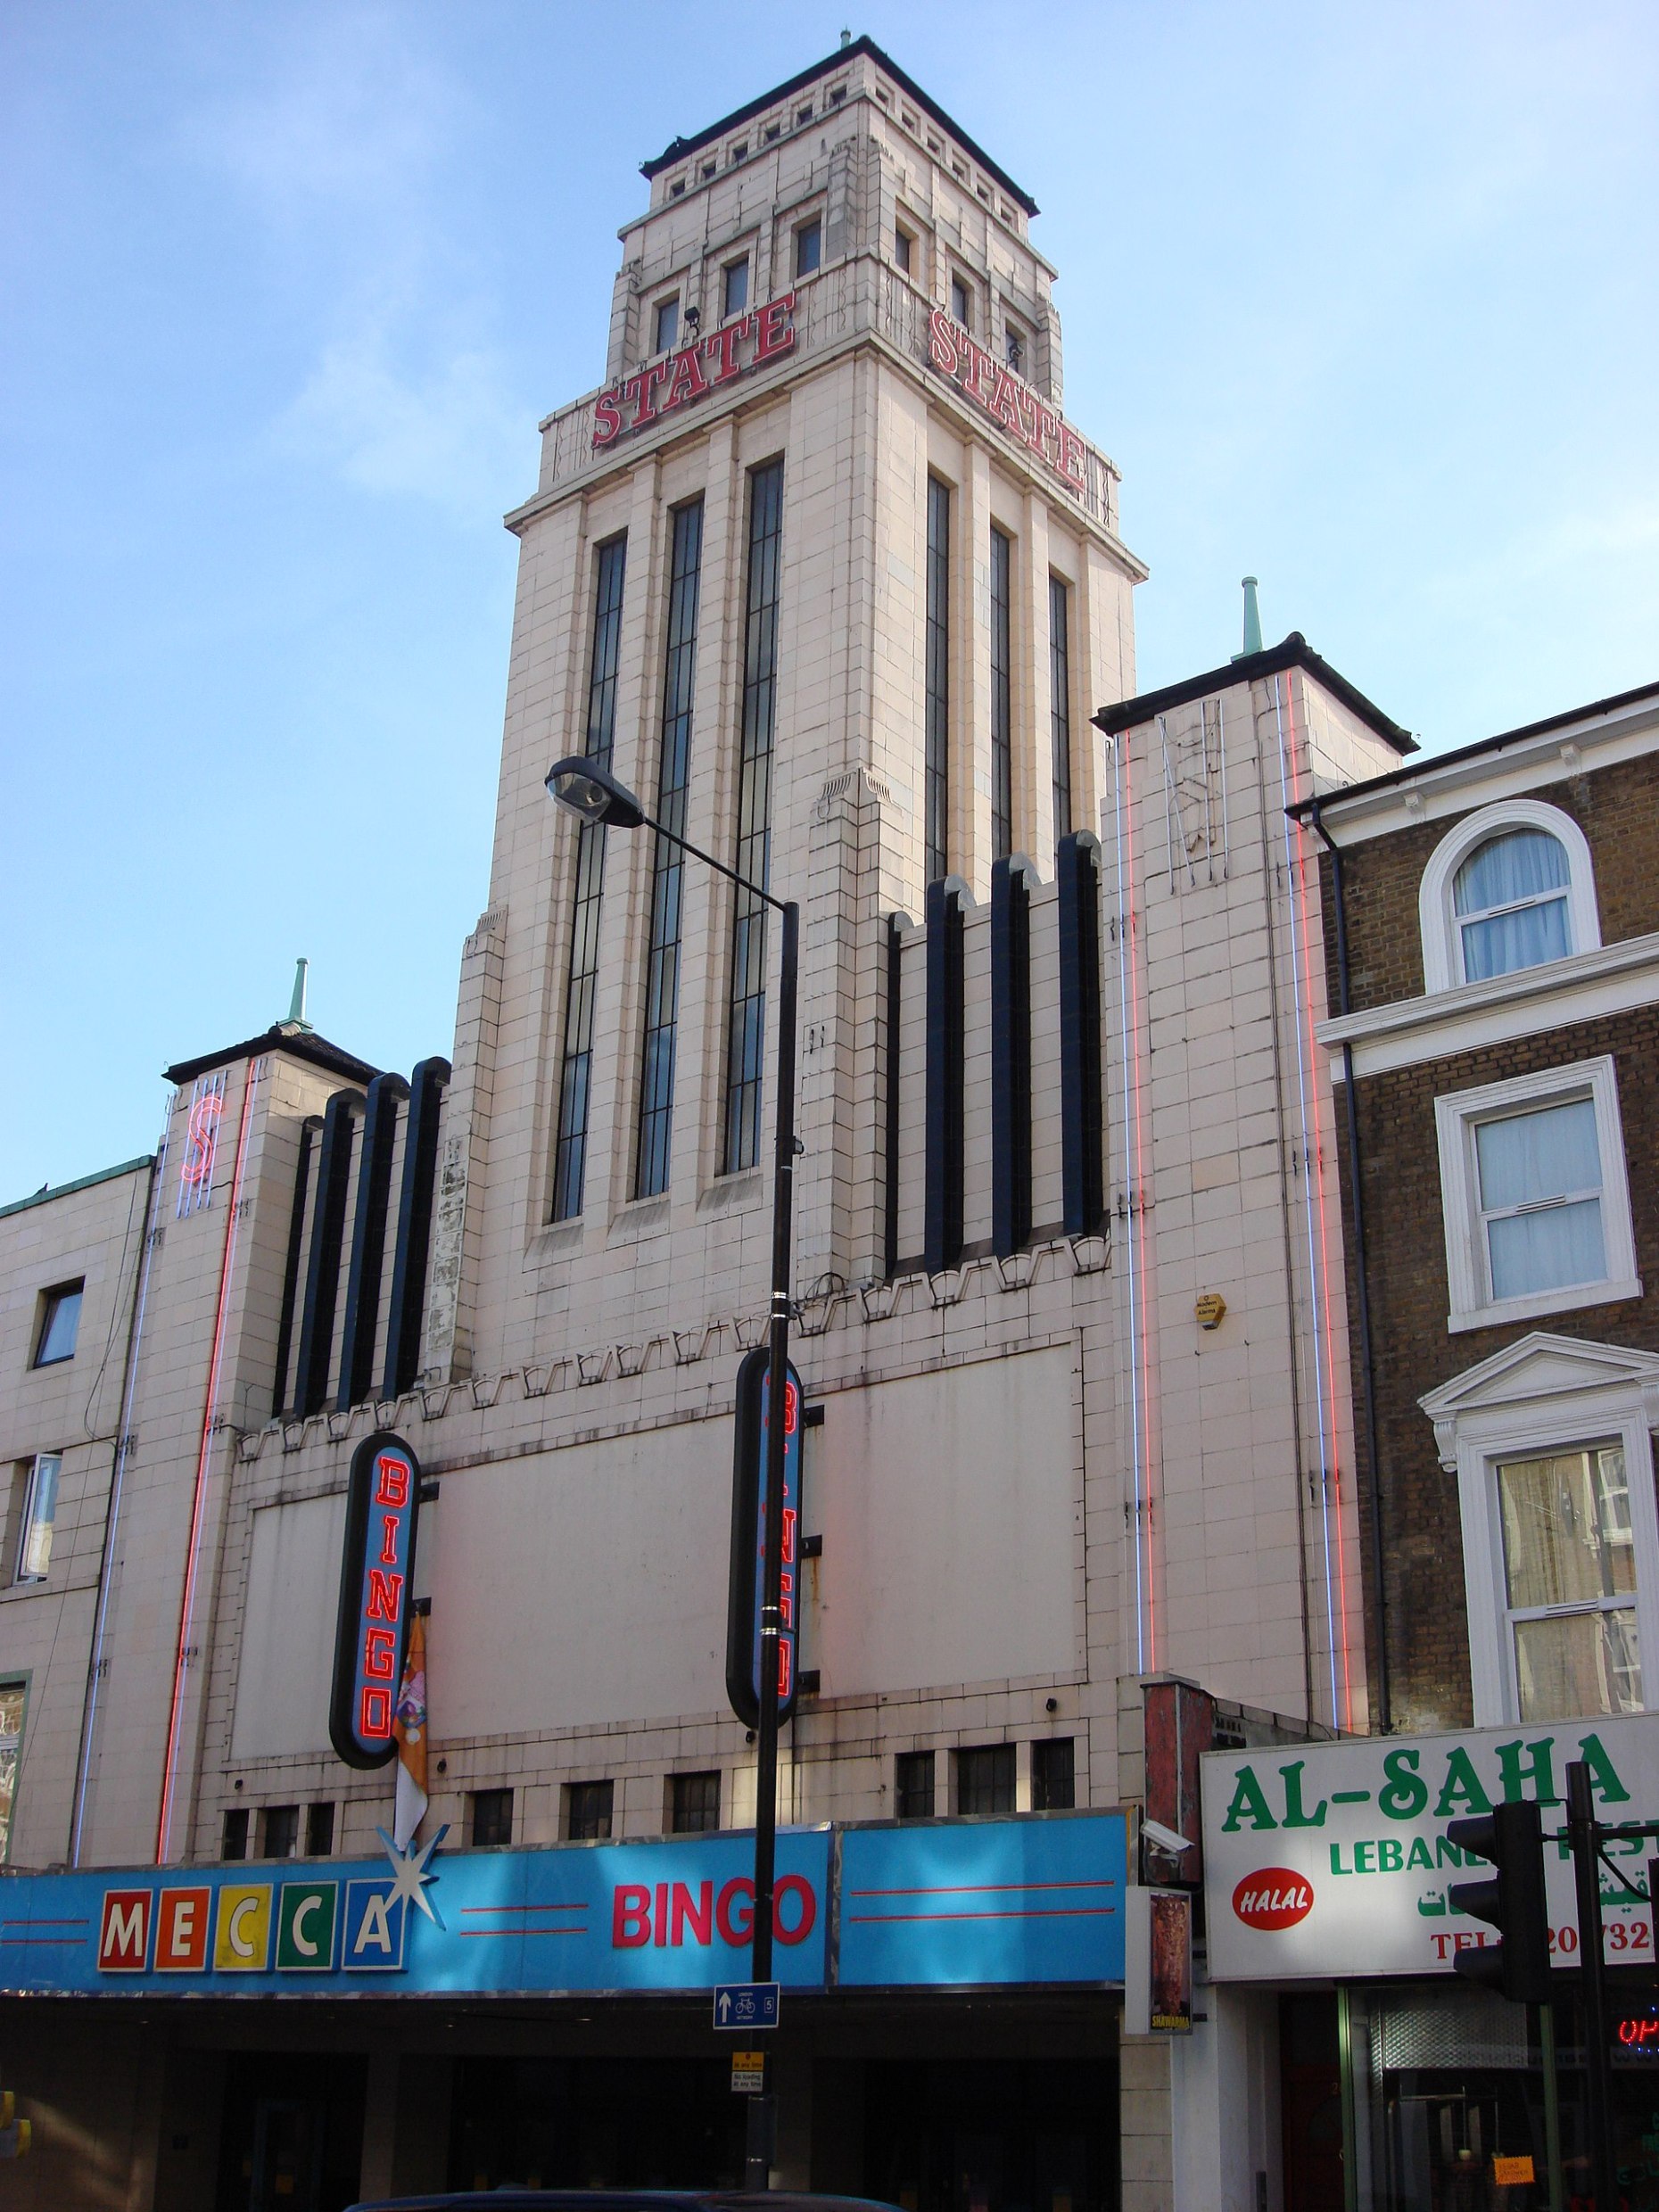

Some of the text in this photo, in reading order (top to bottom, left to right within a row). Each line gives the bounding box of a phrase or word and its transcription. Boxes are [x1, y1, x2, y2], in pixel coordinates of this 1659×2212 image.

[591, 290, 796, 450] STATE
[929, 309, 1087, 498] STATE
[360, 1456, 411, 1738] BINGO
[1221, 1733, 1630, 1832] AL-SAHA
[1330, 1835, 1488, 1875] LEBAN
[103, 1894, 392, 1958] MECCA
[612, 1874, 816, 1948] BINGO
[1240, 1886, 1308, 1913] HALAL
[766, 2000, 772, 2010] 5
[1151, 2015, 1190, 2027] SHAWARMA
